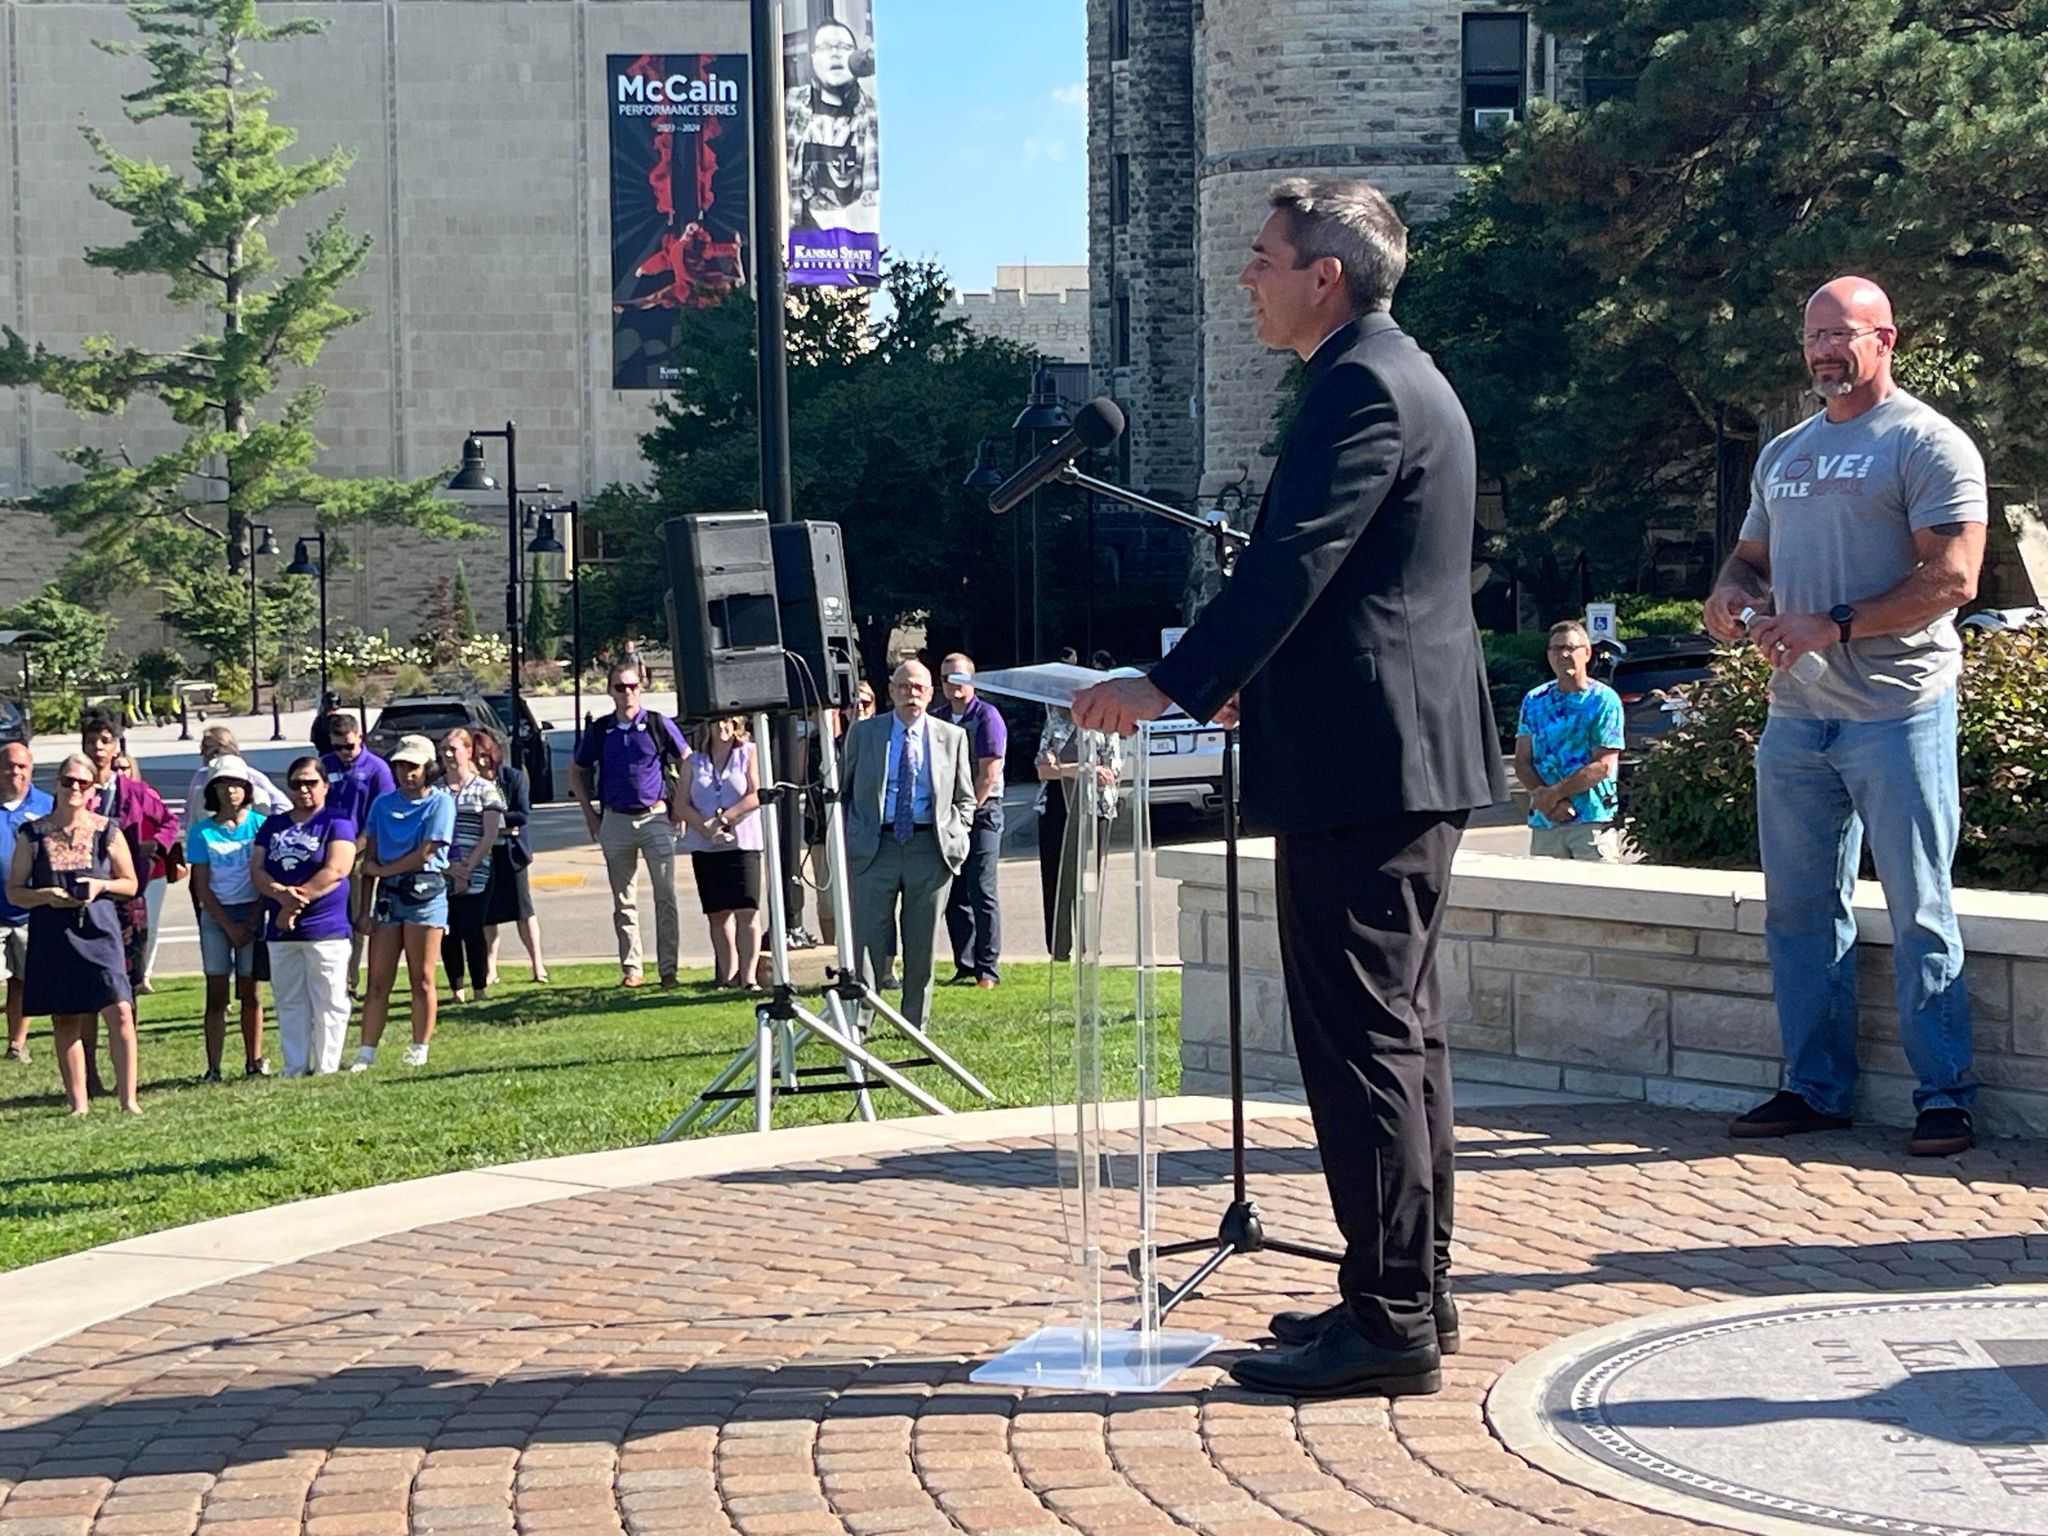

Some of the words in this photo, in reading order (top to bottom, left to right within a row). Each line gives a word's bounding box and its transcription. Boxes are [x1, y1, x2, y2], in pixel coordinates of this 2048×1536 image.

[618, 73, 738, 102] McCain
[619, 104, 700, 116] PERFORMANCE
[702, 104, 738, 116] SERIES
[794, 245, 838, 259] KANSAS
[840, 246, 872, 262] STATE
